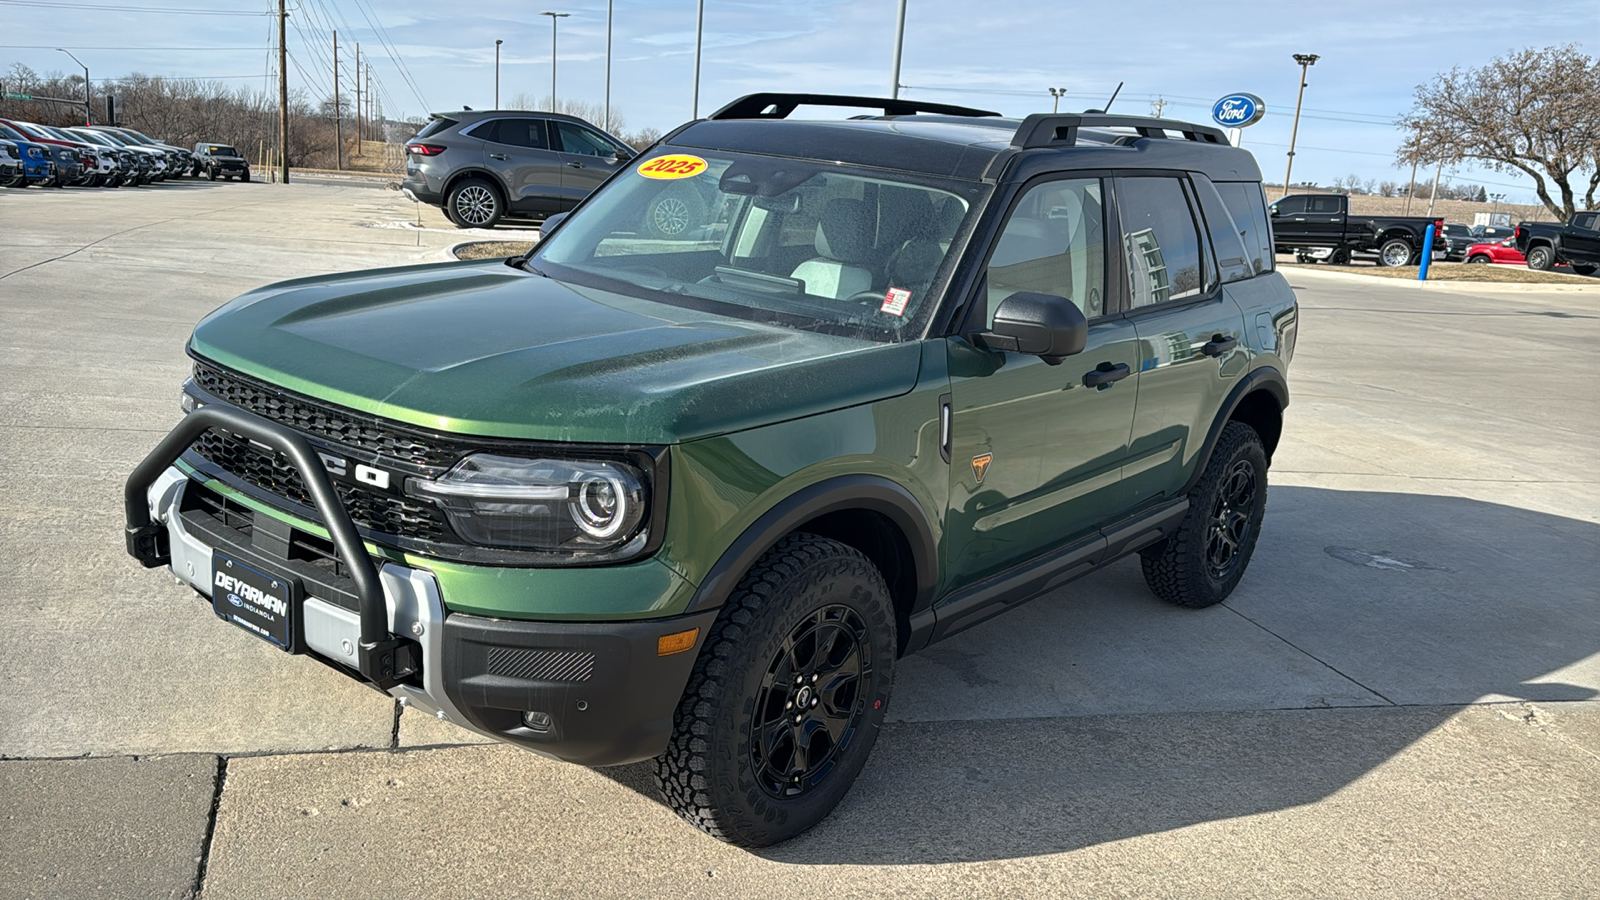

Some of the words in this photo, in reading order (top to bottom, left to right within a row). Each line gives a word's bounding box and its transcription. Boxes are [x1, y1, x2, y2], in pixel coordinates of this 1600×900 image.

[1218, 99, 1248, 120] Ford
[641, 159, 703, 174] 2025
[214, 570, 287, 617] DEYARMAN
[243, 602, 275, 622] INDIANOLA
